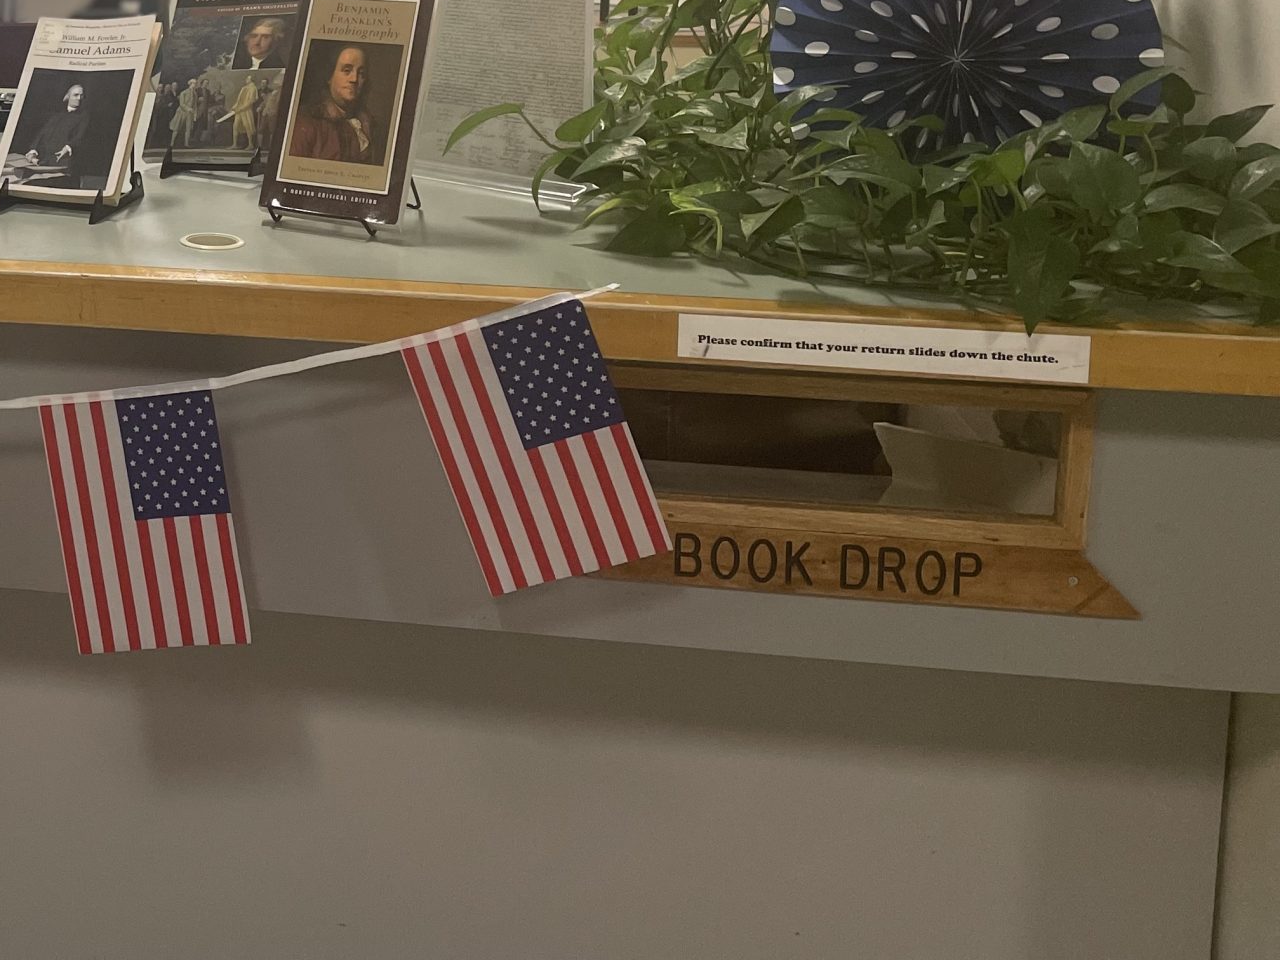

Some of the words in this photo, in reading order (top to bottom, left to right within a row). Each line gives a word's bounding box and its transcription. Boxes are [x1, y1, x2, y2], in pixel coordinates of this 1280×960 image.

[336, 2, 391, 15] BENJAMIN
[330, 13, 392, 26] FRANKLIN'S
[318, 24, 400, 40] Autobiography
[93, 45, 131, 55] Adams
[318, 191, 347, 201] CRITICAL
[697, 334, 737, 346] Please
[740, 337, 793, 349] confirm
[795, 339, 823, 352] that
[825, 343, 860, 354] your
[861, 344, 906, 356] return
[908, 345, 947, 358] slides
[949, 347, 988, 360] down
[991, 350, 1014, 362] the
[1016, 351, 1059, 365] chute.
[674, 532, 813, 586] BOOK
[839, 544, 982, 596] DROP
